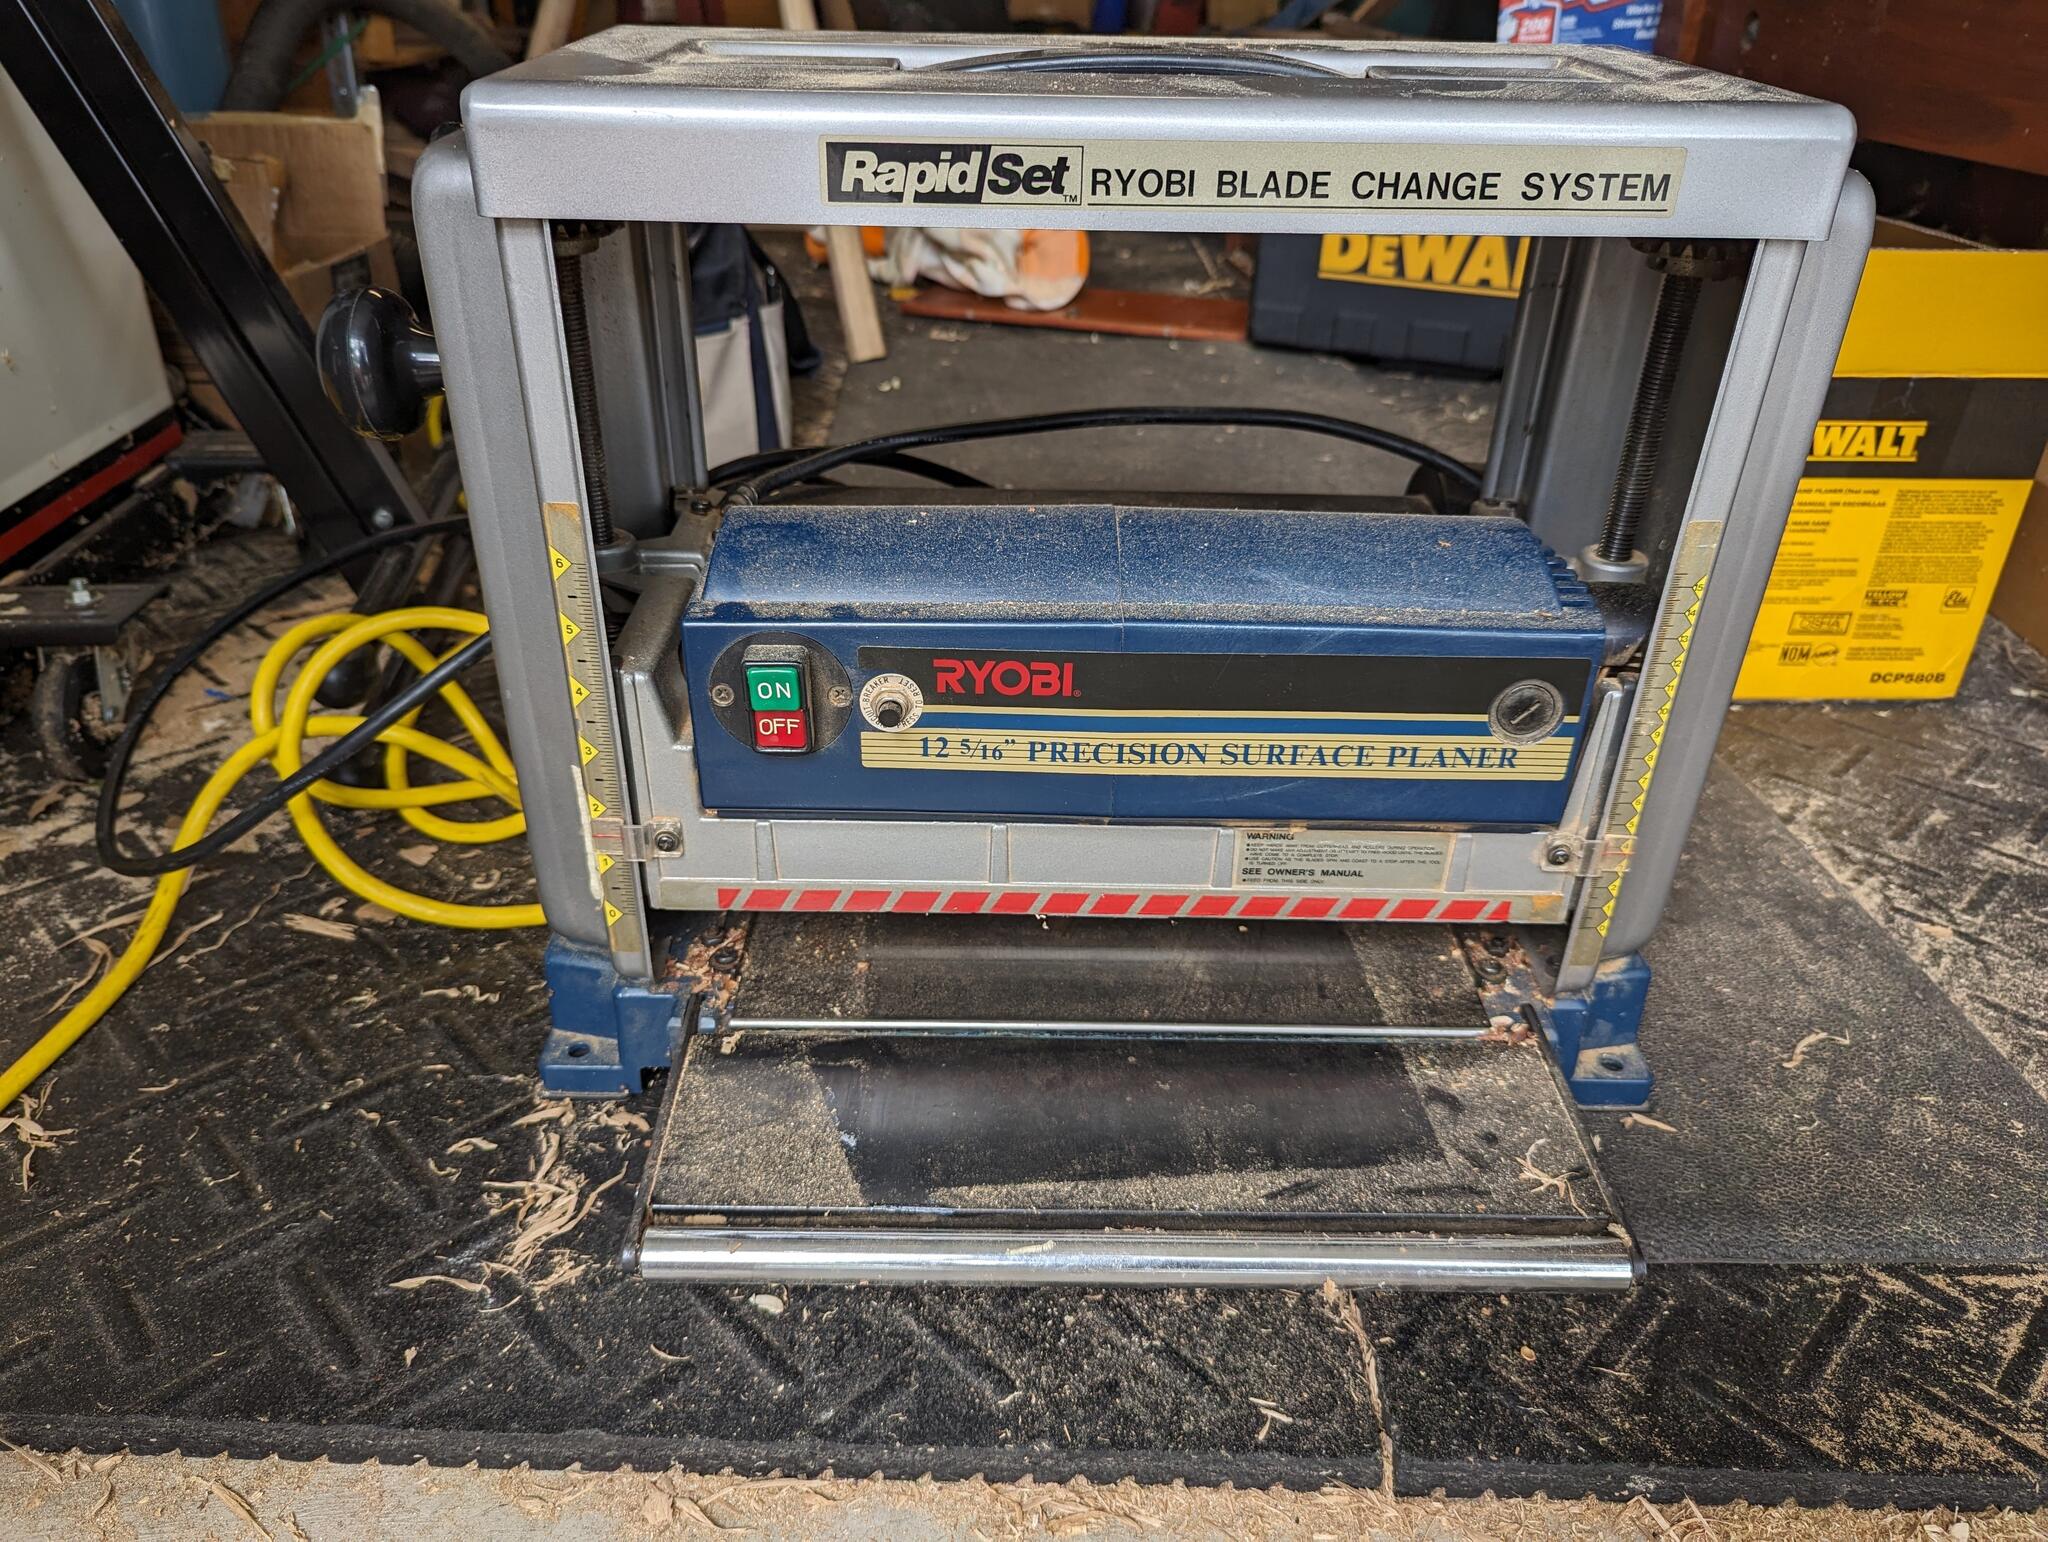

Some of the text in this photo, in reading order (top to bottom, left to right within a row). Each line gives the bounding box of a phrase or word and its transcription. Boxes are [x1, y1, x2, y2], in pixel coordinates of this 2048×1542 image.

[840, 150, 984, 203] Rapid
[987, 153, 1071, 196] Set
[1091, 168, 1671, 202] RYOBI BLADE CHANGE SYSTEM
[1811, 421, 1928, 460] WALT
[555, 558, 564, 568] 6
[566, 625, 574, 634] 5
[932, 658, 1075, 698] RYOBI
[575, 688, 583, 696] 4
[757, 682, 792, 700] ON
[759, 718, 801, 736] OFF
[585, 746, 592, 755] 3
[920, 736, 949, 758] 12
[1027, 740, 1209, 766] PRECISION
[1219, 742, 1375, 769] SURFACE
[1386, 745, 1520, 770] PLANER
[592, 803, 600, 812] 2
[1247, 833, 1295, 841] WARNING
[602, 858, 608, 866] 1
[1242, 867, 1364, 878] SEE OWNER'S MANUAL
[608, 909, 617, 918] 0
